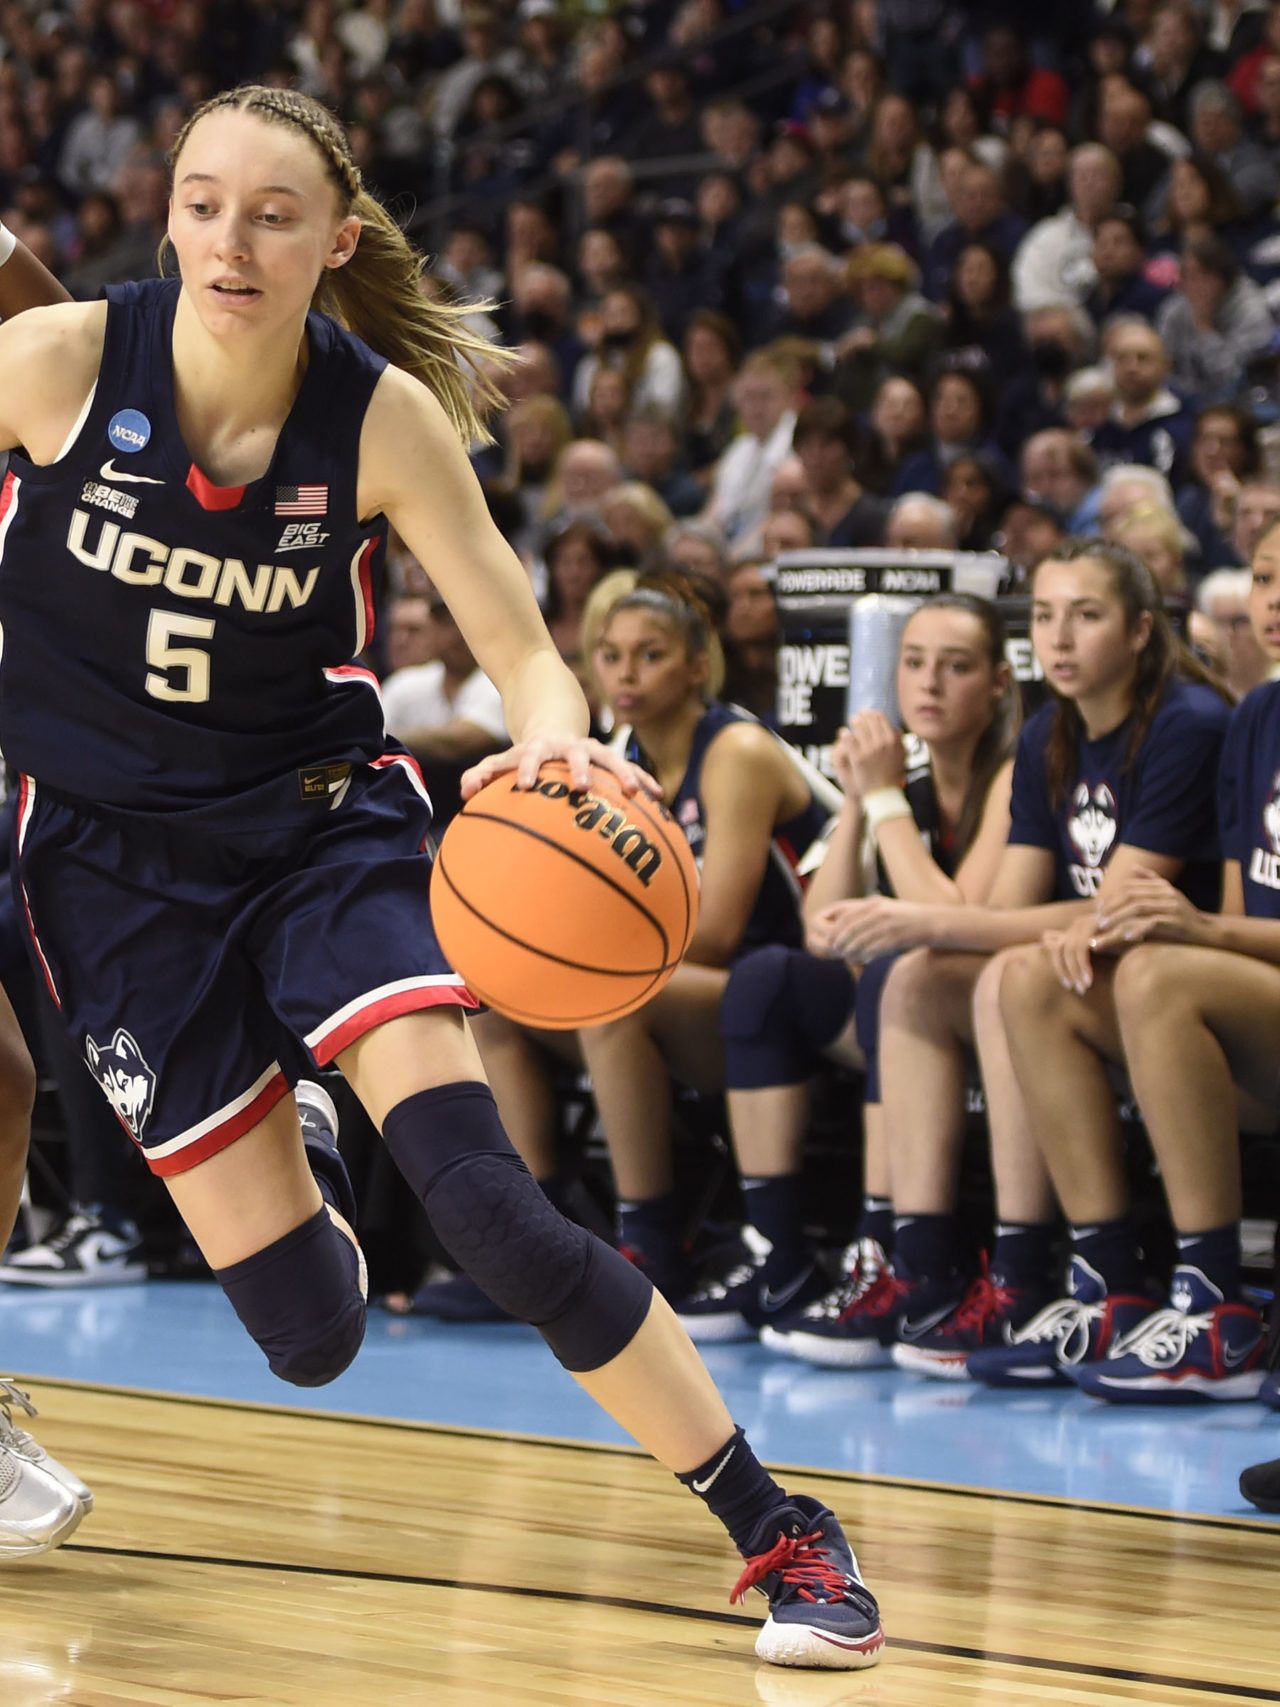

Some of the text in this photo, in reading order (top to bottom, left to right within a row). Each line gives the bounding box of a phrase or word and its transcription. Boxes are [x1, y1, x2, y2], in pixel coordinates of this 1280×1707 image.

[112, 425, 147, 447] NCAA
[81, 493, 135, 519] CHANGE
[278, 533, 330, 547] EAST
[283, 522, 322, 535] BIG
[67, 508, 320, 613] UCONN
[145, 608, 216, 703] 5
[779, 644, 850, 687] OWE
[779, 686, 813, 726] DE
